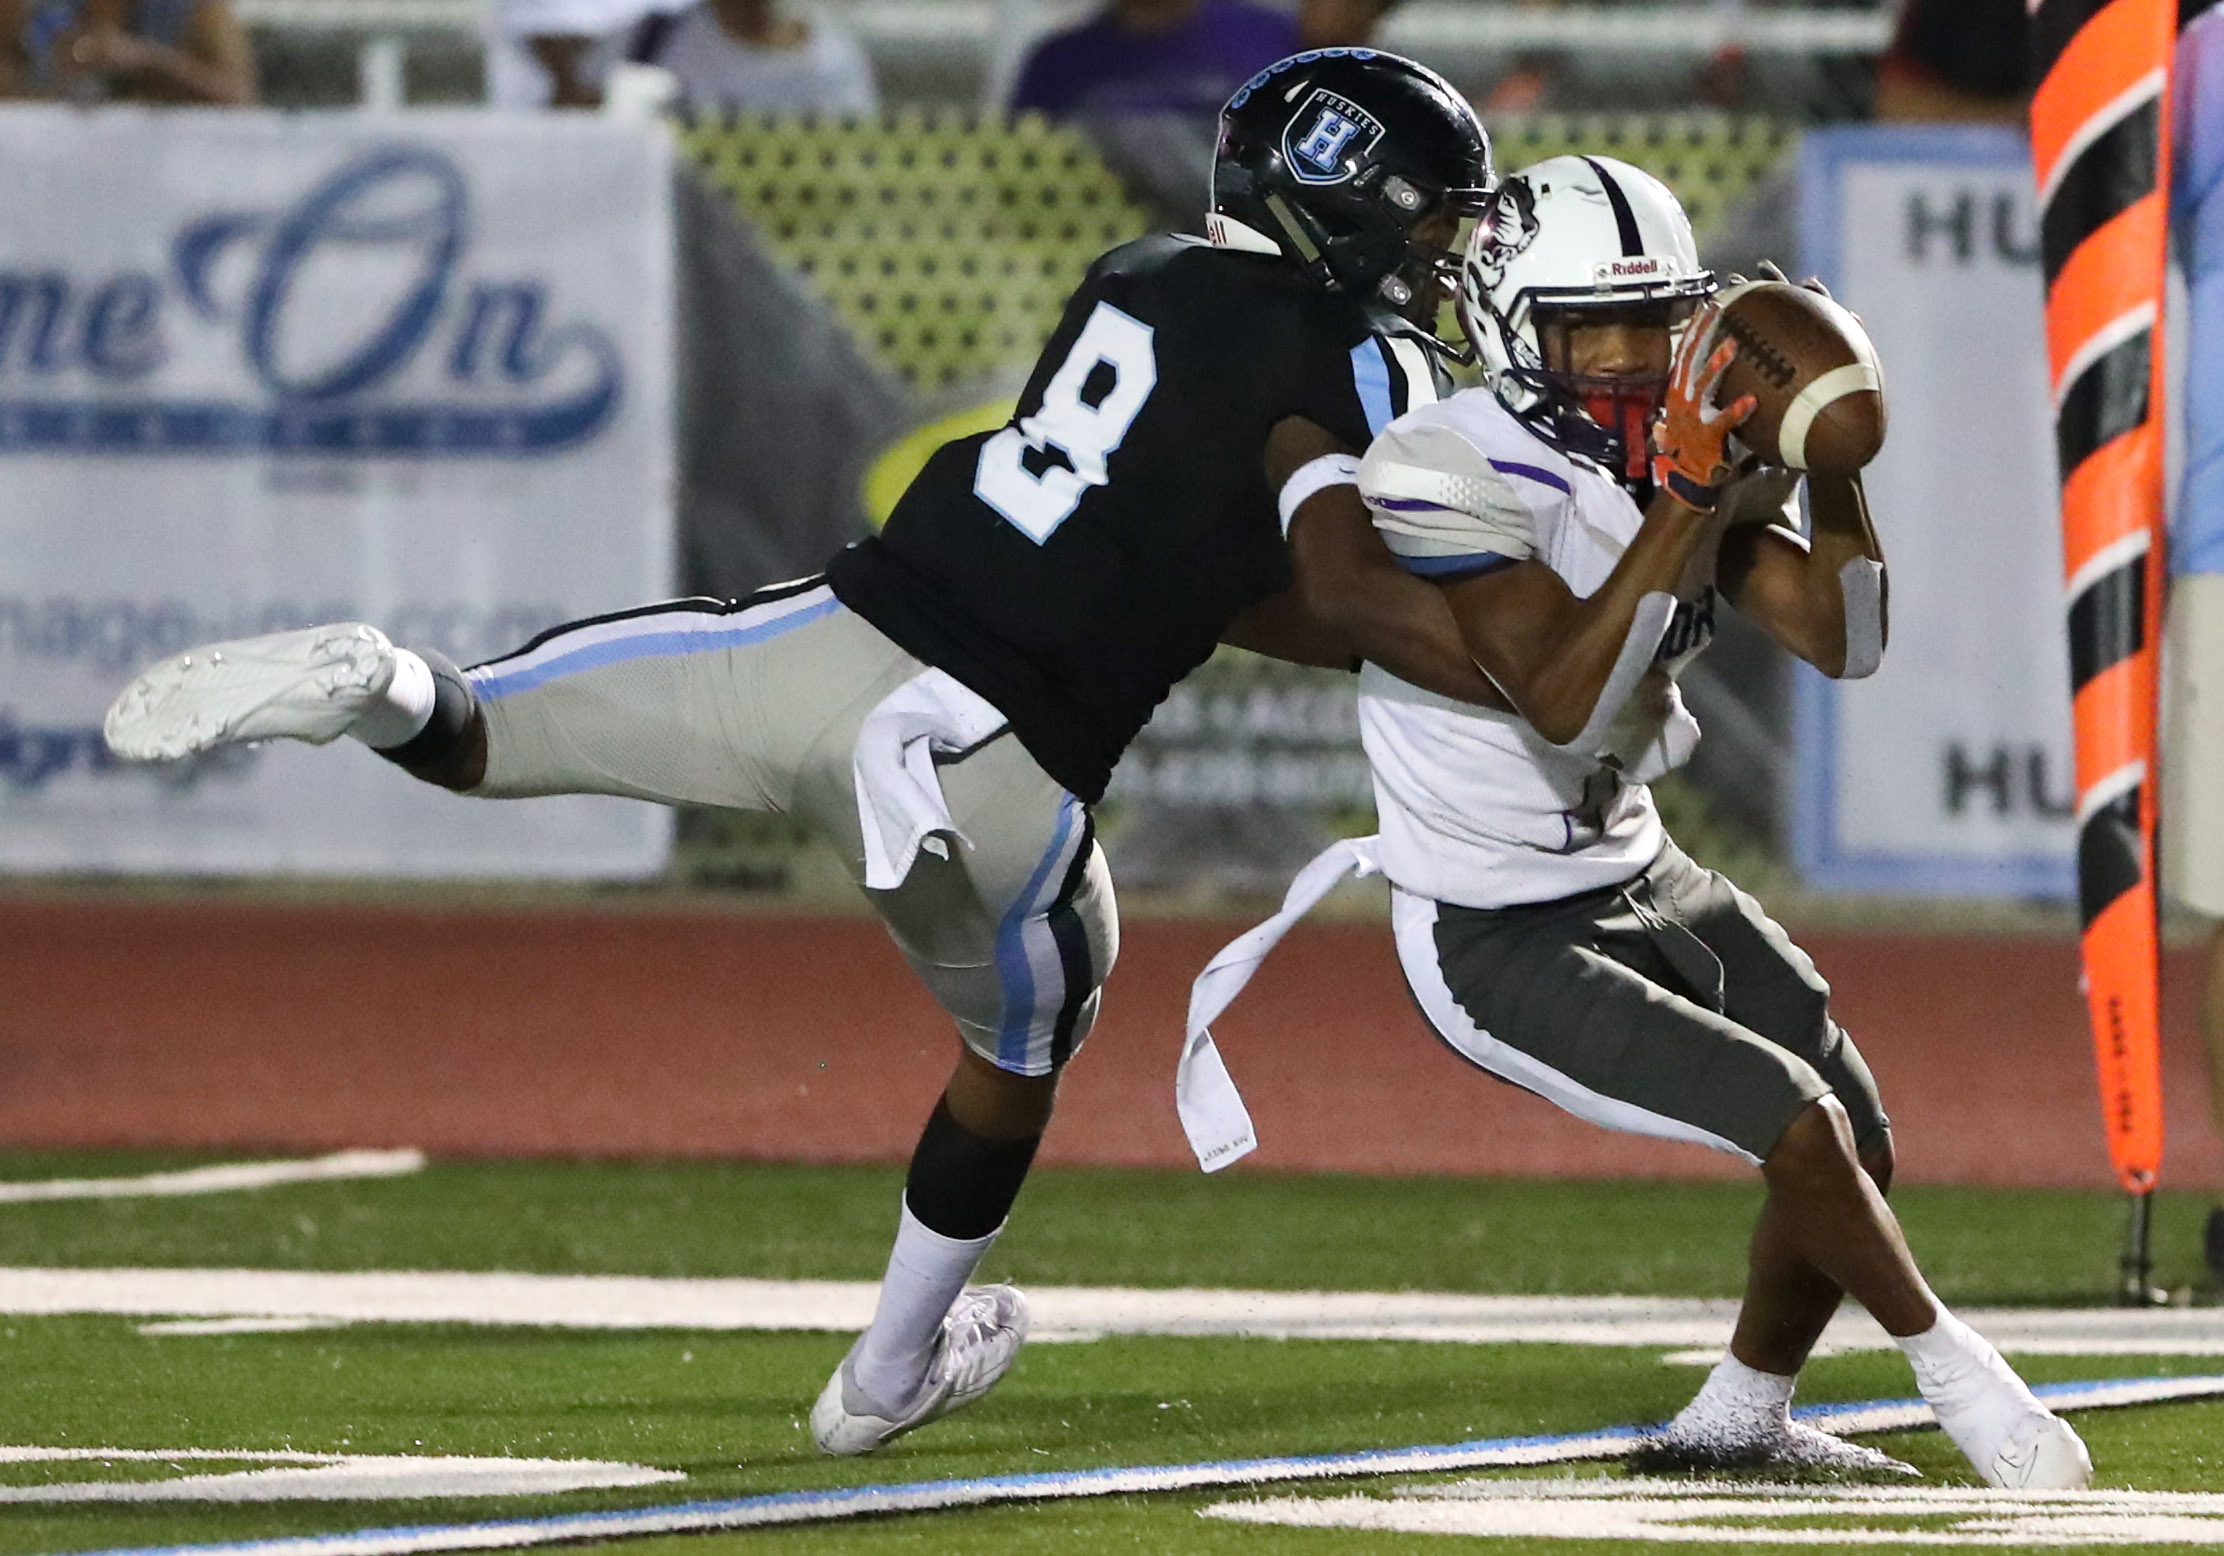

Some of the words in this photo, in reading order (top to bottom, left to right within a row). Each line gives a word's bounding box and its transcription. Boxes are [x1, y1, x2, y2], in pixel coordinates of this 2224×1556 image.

[1294, 106, 1361, 173] H
[1316, 92, 1379, 136] HUSKIES
[1905, 188, 2044, 264] HU
[1611, 259, 1659, 276] Riddell
[972, 299, 1159, 547] 8
[1944, 742, 2076, 820] HU
